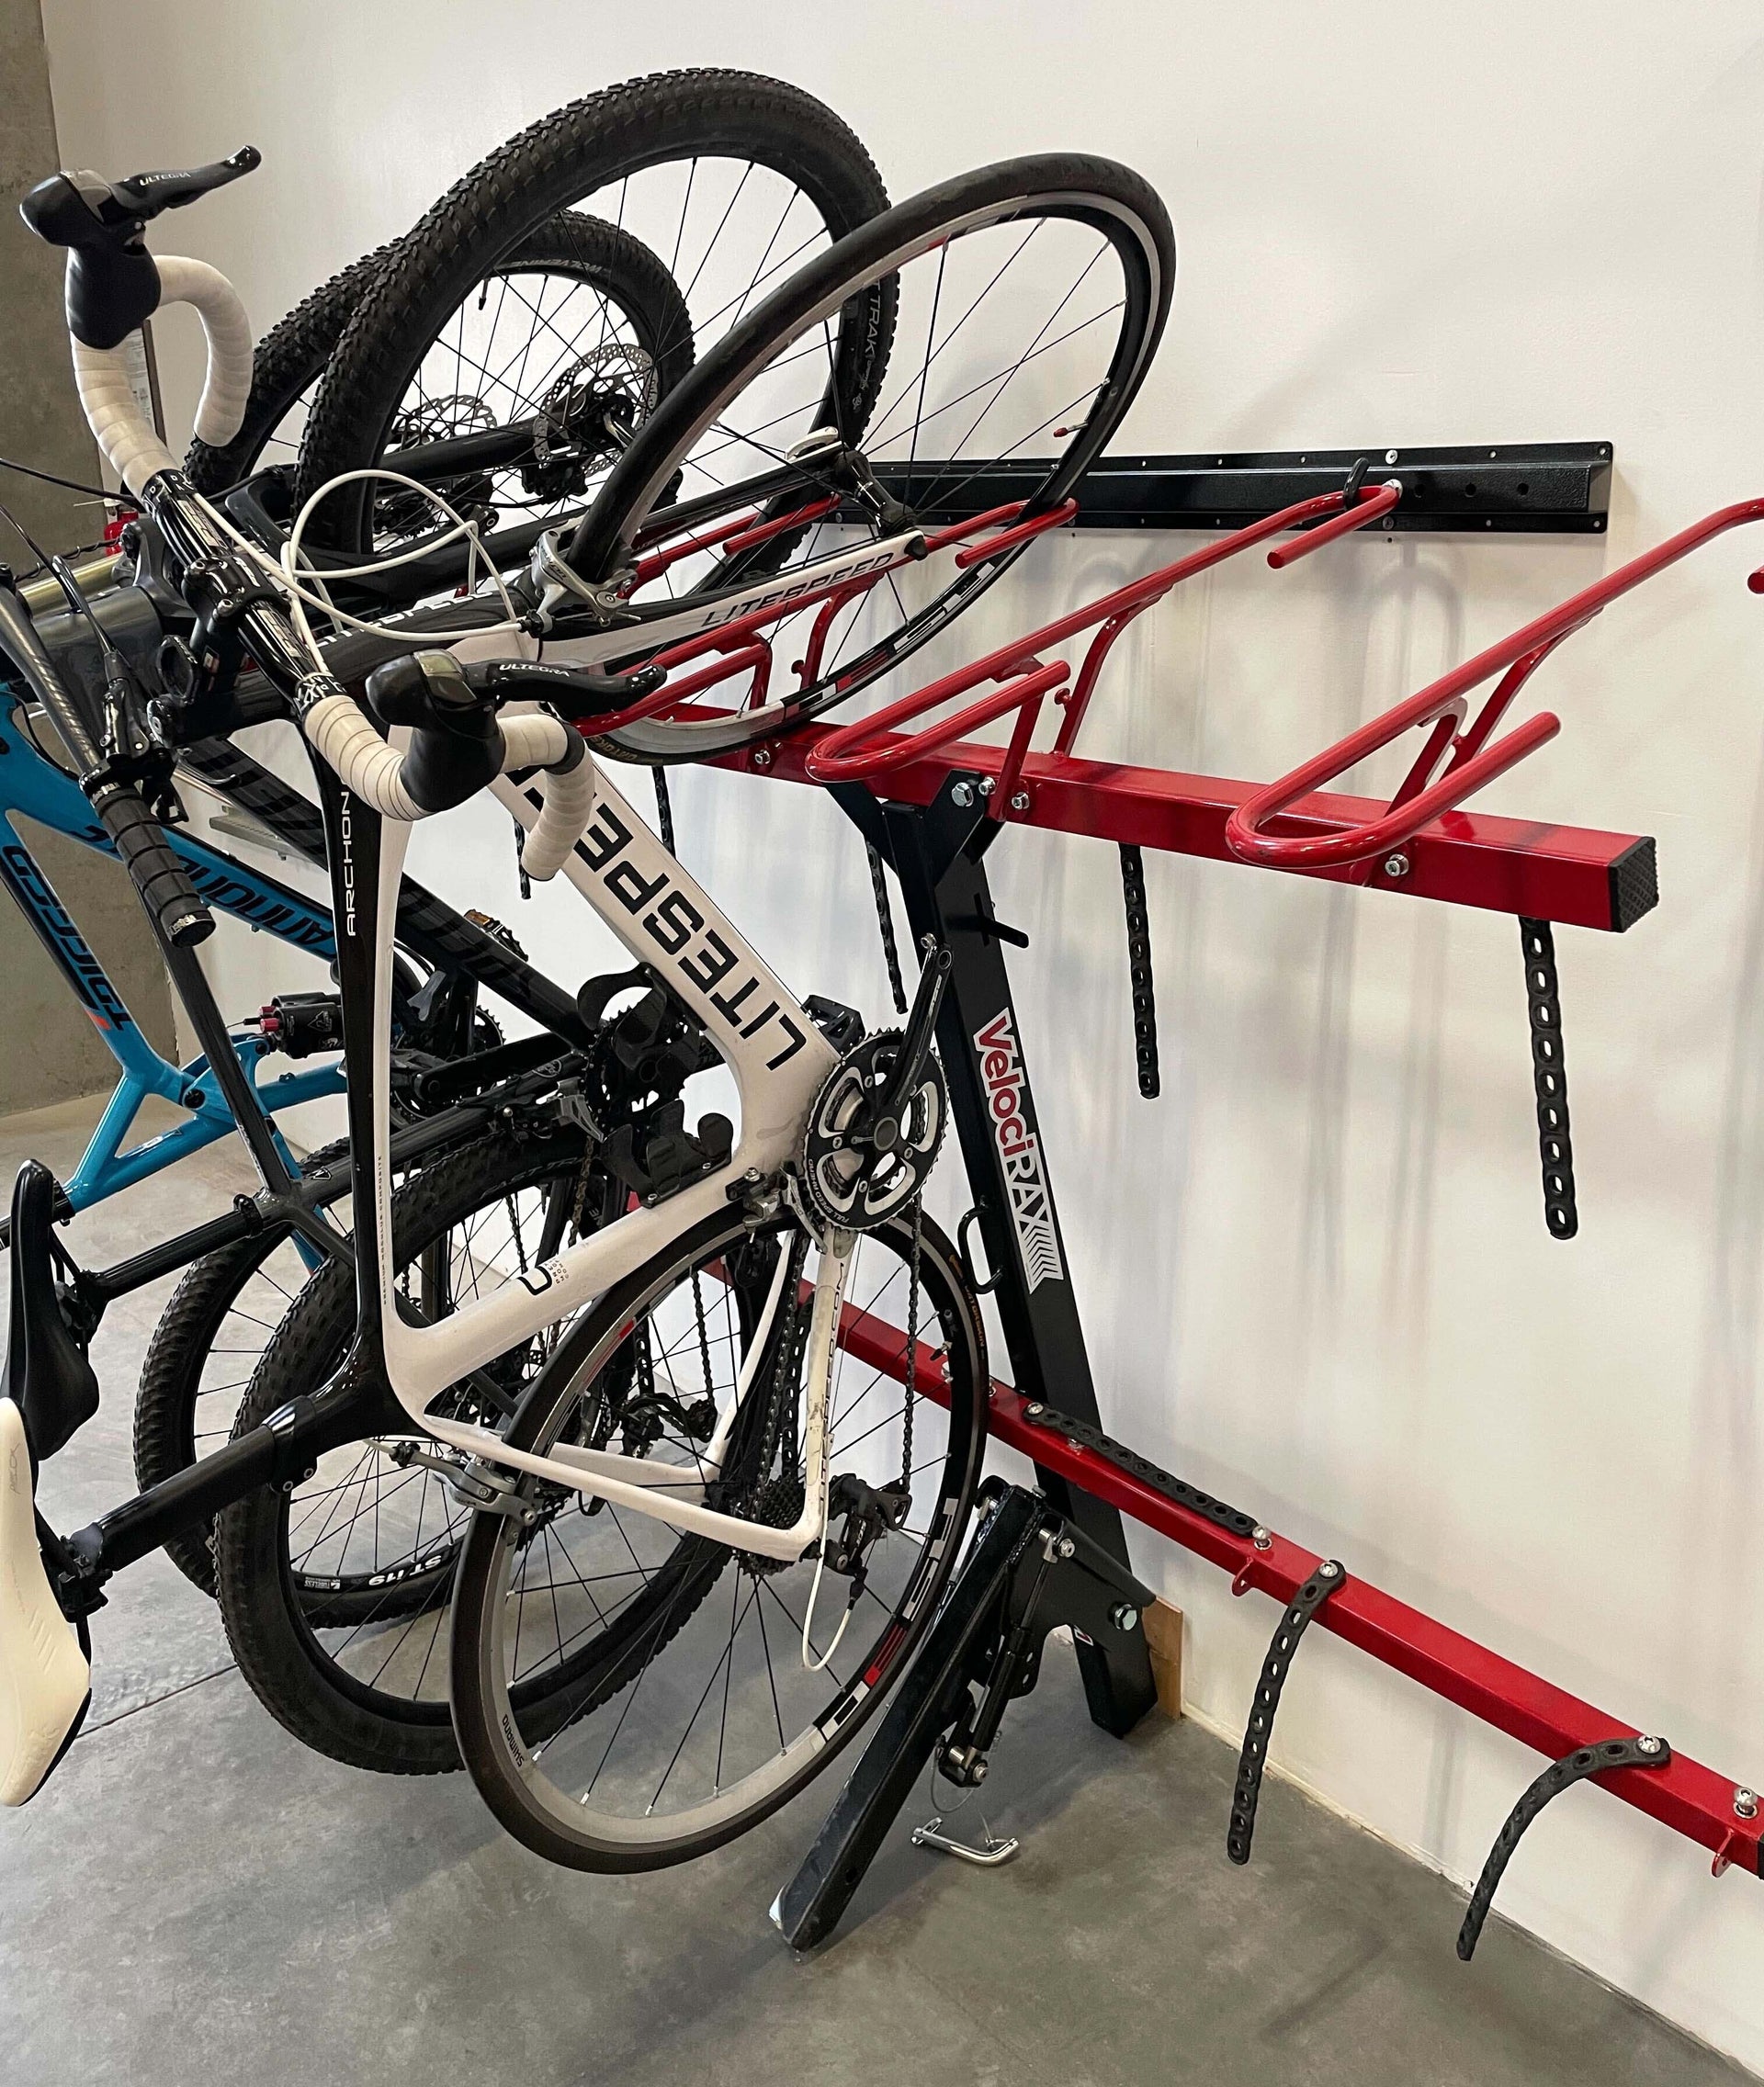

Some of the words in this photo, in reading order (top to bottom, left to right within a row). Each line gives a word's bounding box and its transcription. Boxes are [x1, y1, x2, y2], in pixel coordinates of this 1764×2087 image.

[140, 172, 191, 186] ULTEGRA
[701, 552, 894, 628] LITESPEED
[499, 663, 571, 678] ULTEGRA
[341, 791, 356, 937] ARCHON
[507, 768, 808, 1072] LITESPE
[978, 1014, 1051, 1238] VelociRAX
[815, 1191, 834, 1213] SPEED
[409, 1555, 442, 1576] ST
[502, 1713, 525, 1767] SHIMANO
